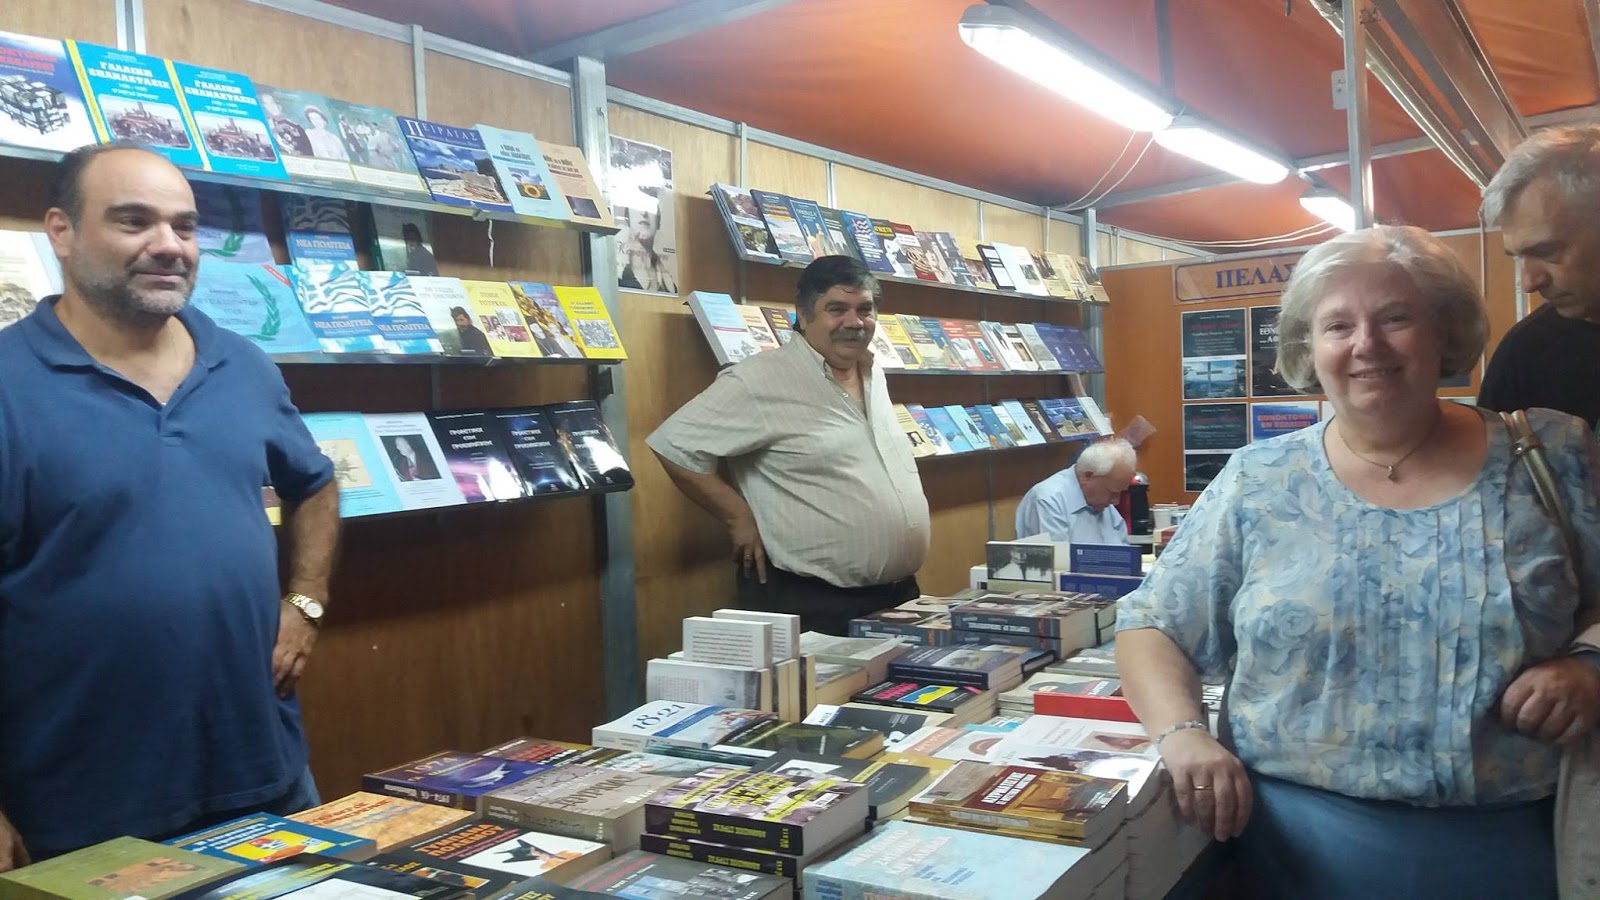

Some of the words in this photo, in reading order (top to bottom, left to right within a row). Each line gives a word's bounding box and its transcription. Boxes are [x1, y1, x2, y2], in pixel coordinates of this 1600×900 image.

[405, 119, 478, 141] ΠΕΙΡΑΙΑΣ
[632, 704, 686, 730] 1821
[414, 824, 494, 853] ΤΥΜΠΑΝΑ
[427, 825, 505, 857] ΠΟΛΕΜΟΥ
